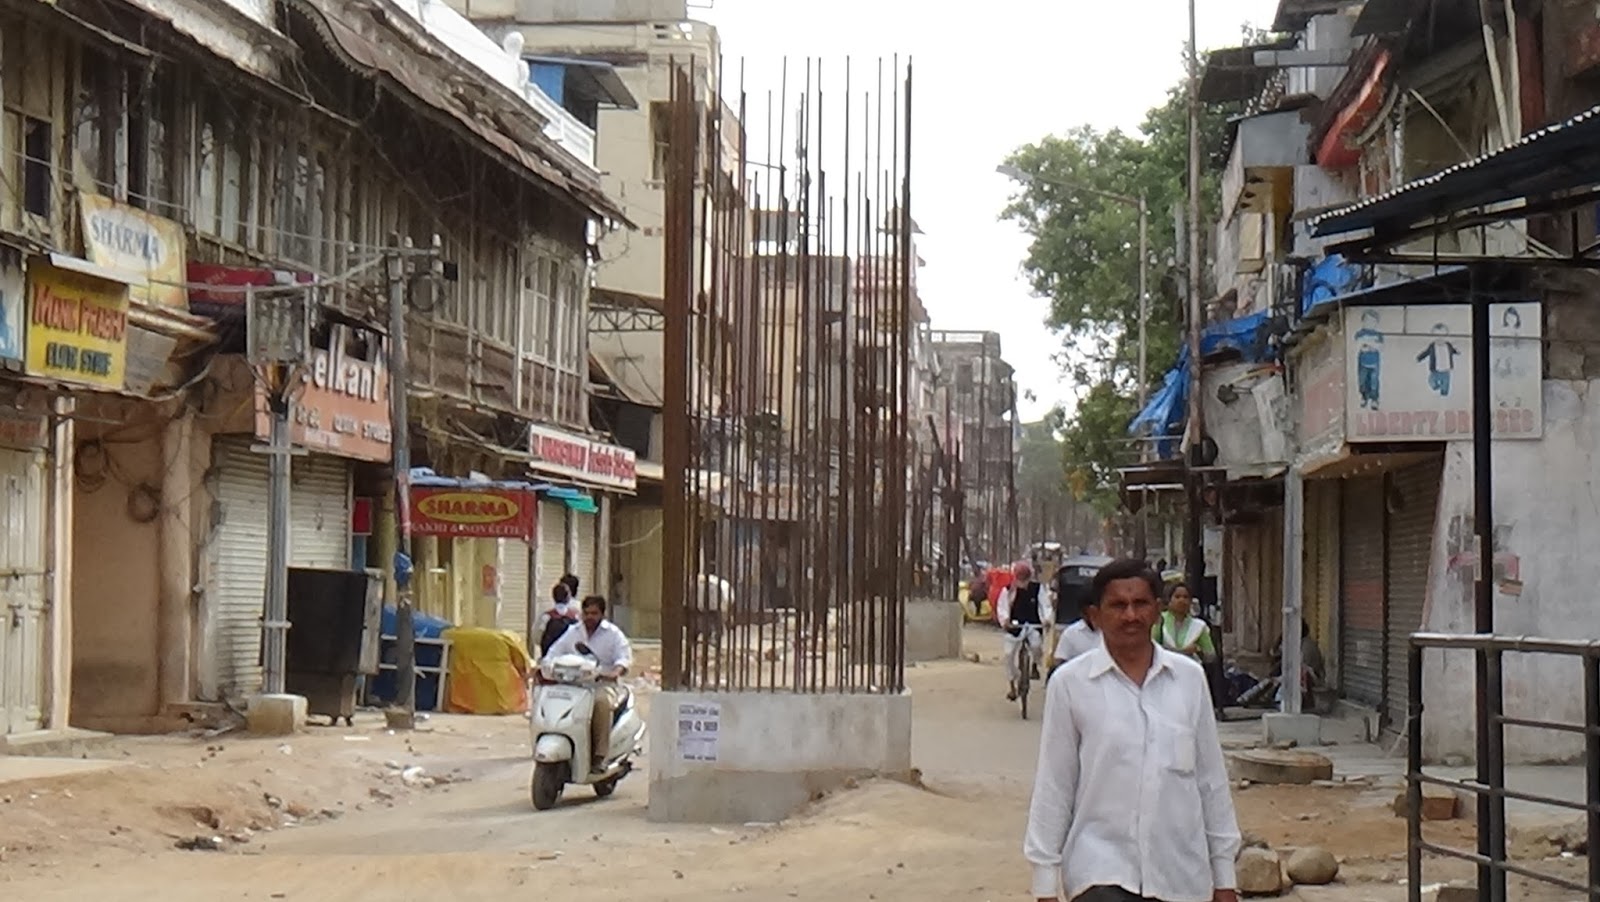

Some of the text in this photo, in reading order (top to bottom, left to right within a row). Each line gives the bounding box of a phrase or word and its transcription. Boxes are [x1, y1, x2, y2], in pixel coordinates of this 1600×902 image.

[90, 215, 161, 264] SHARMA
[1355, 410, 1439, 436] LIBERTY
[426, 499, 510, 516] SHARMA
